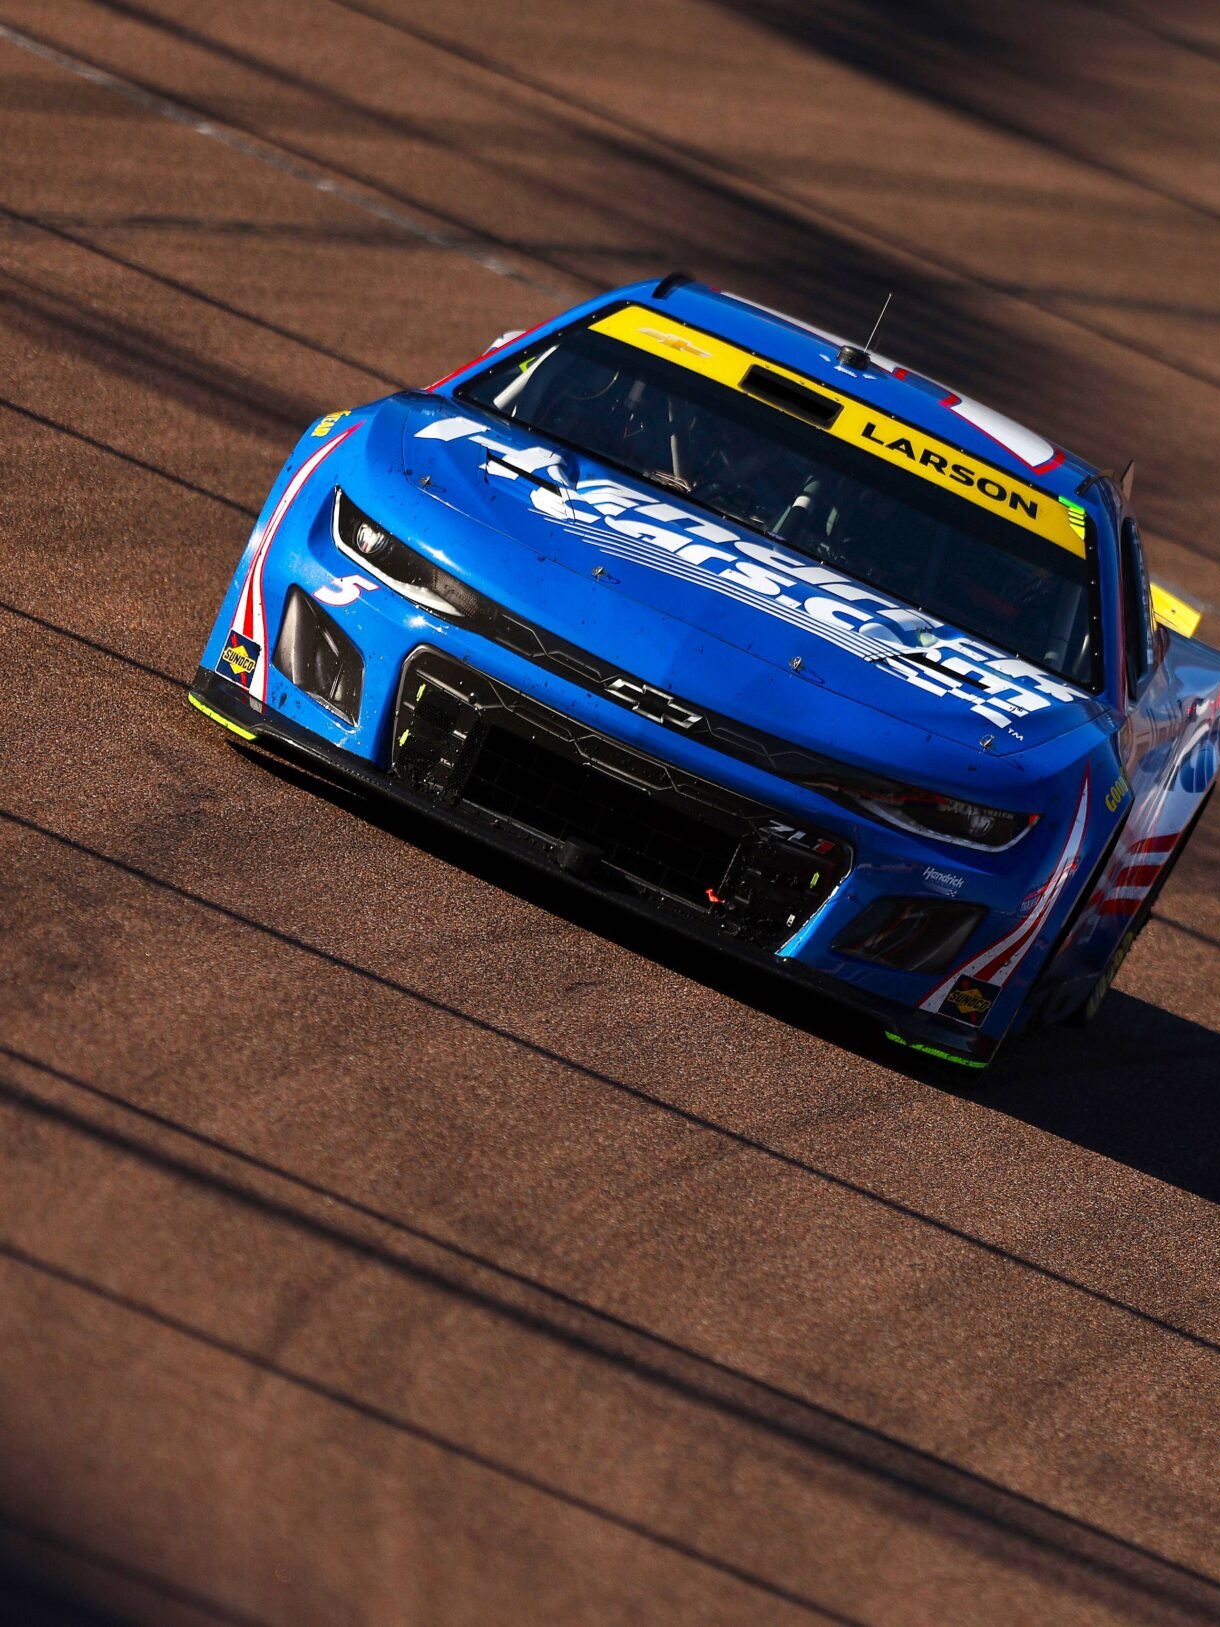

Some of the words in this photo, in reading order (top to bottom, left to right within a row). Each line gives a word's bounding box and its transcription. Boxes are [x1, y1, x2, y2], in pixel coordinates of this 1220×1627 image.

[861, 422, 1039, 520] LARSON
[312, 574, 382, 607] 5
[224, 648, 255, 671] SUNOCO
[1008, 728, 1025, 741] TM
[758, 819, 836, 855] ZL1
[923, 866, 965, 888] Hendrick
[949, 991, 990, 1011] SUNOCO
